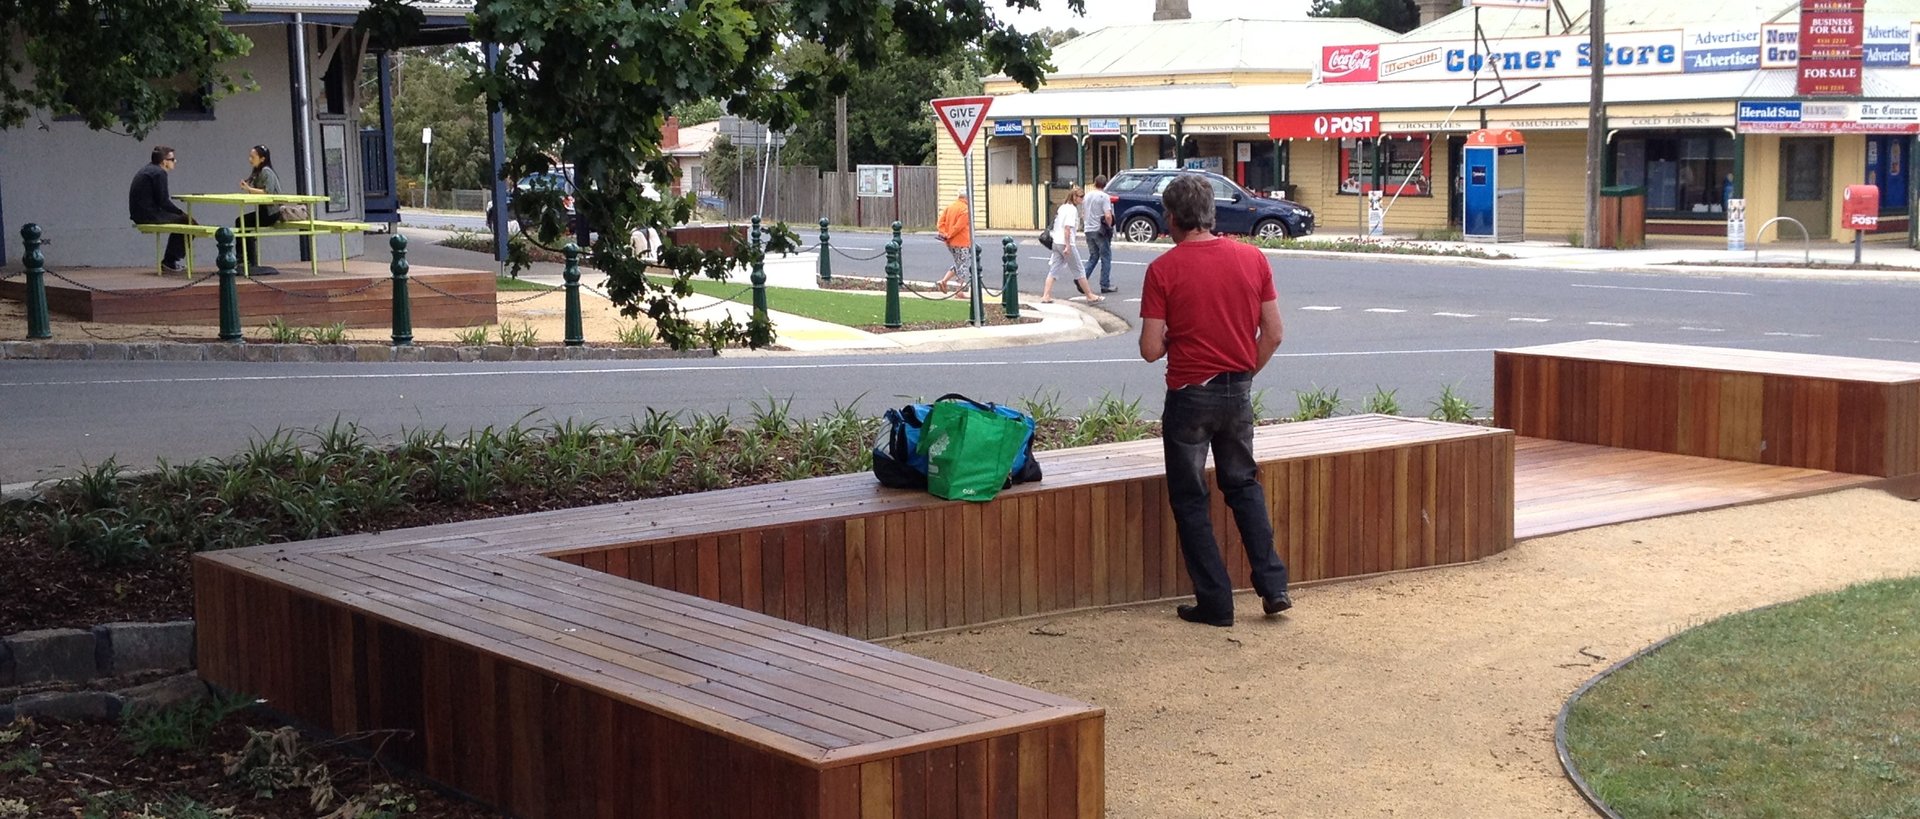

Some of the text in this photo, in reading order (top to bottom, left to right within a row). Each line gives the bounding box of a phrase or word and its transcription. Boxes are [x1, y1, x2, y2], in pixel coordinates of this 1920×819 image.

[1812, 18, 1853, 26] BUSINESS
[1810, 26, 1855, 34] FOR SALE
[1867, 25, 1909, 39] Advertiser
[1696, 30, 1759, 45] Advertiser
[1446, 43, 1676, 72] Corner Store
[1866, 47, 1910, 61] Advertiser
[1384, 52, 1438, 73] Meredith
[1694, 52, 1759, 68] Advertiser
[1804, 69, 1857, 78] FOR SALE
[950, 107, 976, 119] GIVE
[1740, 107, 1800, 118] Herald Sun
[1861, 105, 1879, 115] The
[1882, 105, 1918, 115] Courier
[954, 119, 971, 128] WAY
[1041, 122, 1069, 132] Sunday
[1200, 124, 1257, 132] NEWSPAPERS
[1330, 116, 1373, 134] POST
[1398, 122, 1461, 130] GROCERIES
[1509, 119, 1578, 127] AMMUNITION
[1851, 216, 1878, 225] POST
